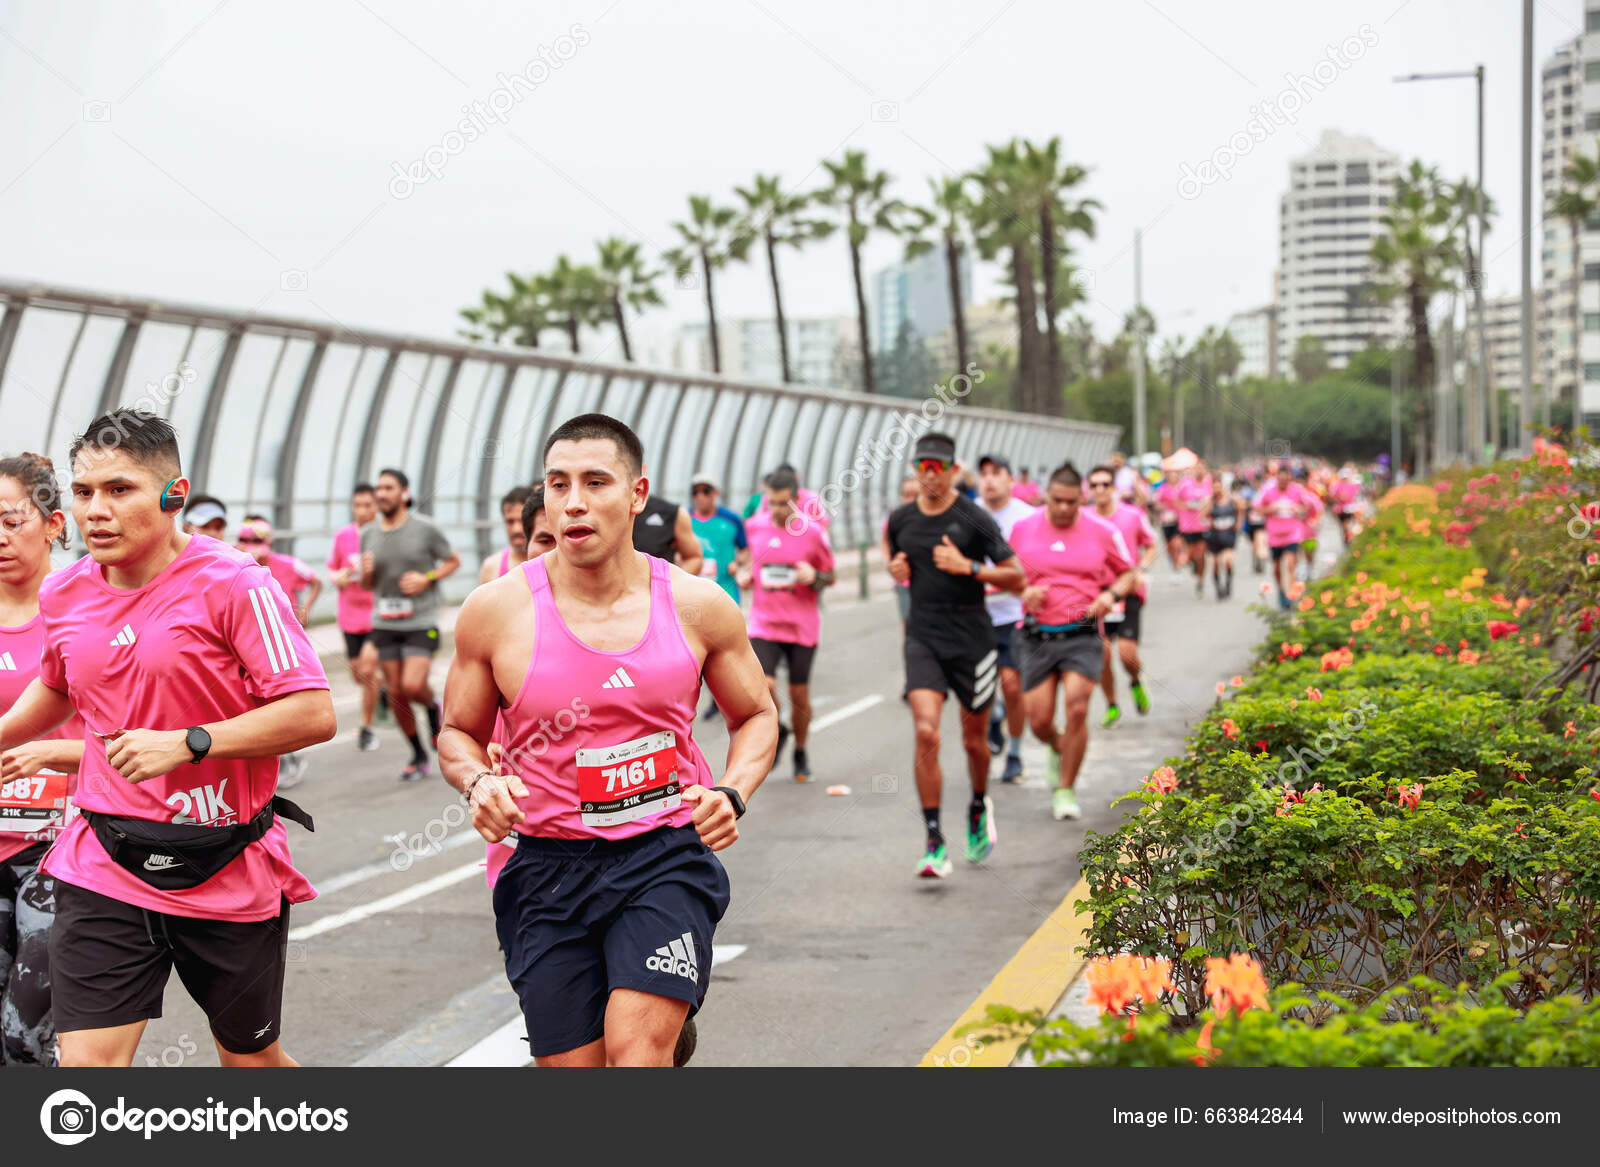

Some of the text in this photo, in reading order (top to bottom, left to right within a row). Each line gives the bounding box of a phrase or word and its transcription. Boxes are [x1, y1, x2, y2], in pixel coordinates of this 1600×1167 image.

[601, 757, 656, 792] 7161
[166, 778, 235, 824] 21K
[623, 795, 640, 807] 21K
[2, 808, 21, 817] 21K
[148, 853, 174, 866] NIKE
[646, 956, 699, 986] adida
